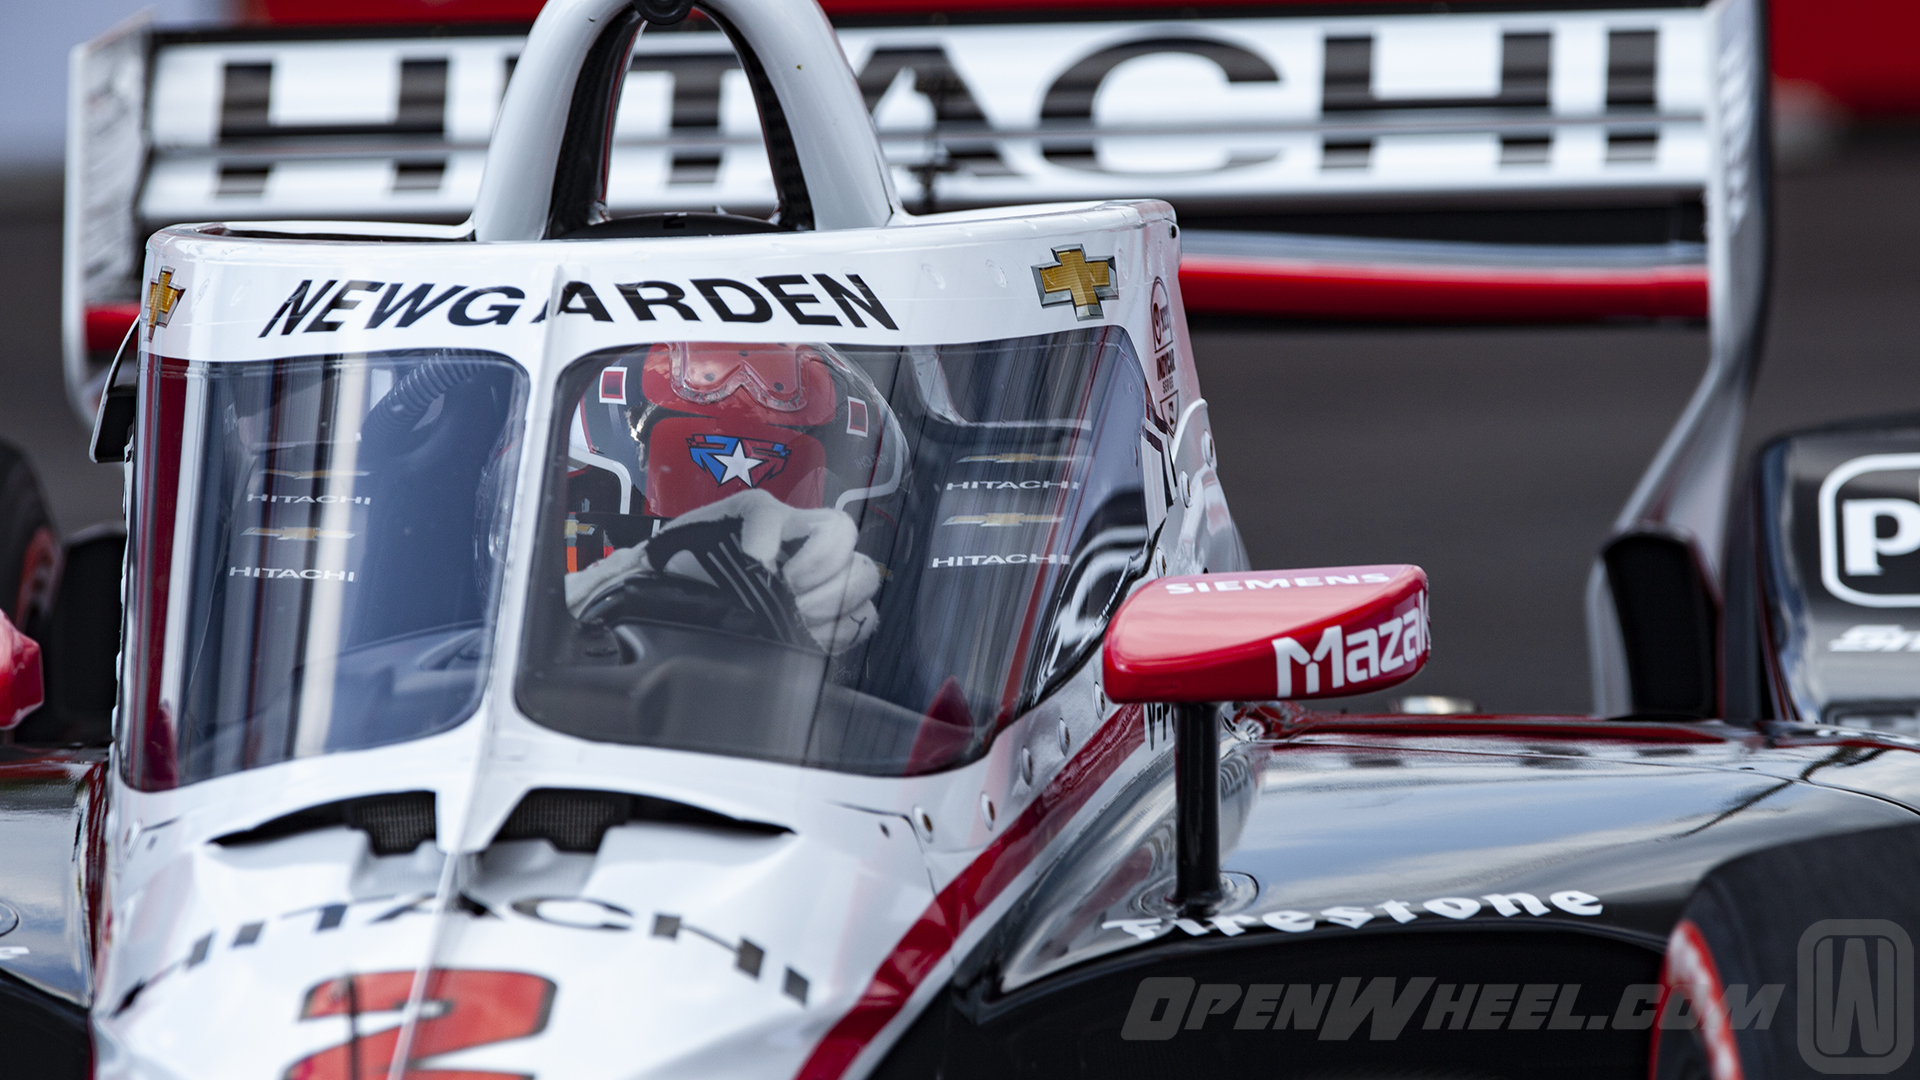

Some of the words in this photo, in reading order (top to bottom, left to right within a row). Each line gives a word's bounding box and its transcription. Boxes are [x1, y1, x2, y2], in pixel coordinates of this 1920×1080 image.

[215, 26, 1658, 196] HTACHI
[259, 274, 899, 338] NEWGARDEN
[944, 480, 1081, 491] HITACHI
[246, 494, 371, 505] HITACHI
[932, 554, 1072, 568] HITACHI
[229, 567, 355, 582] HITACHI
[1165, 572, 1390, 595] SIEMENS
[1102, 890, 1604, 939] Firestone
[281, 969, 557, 1080] 2
